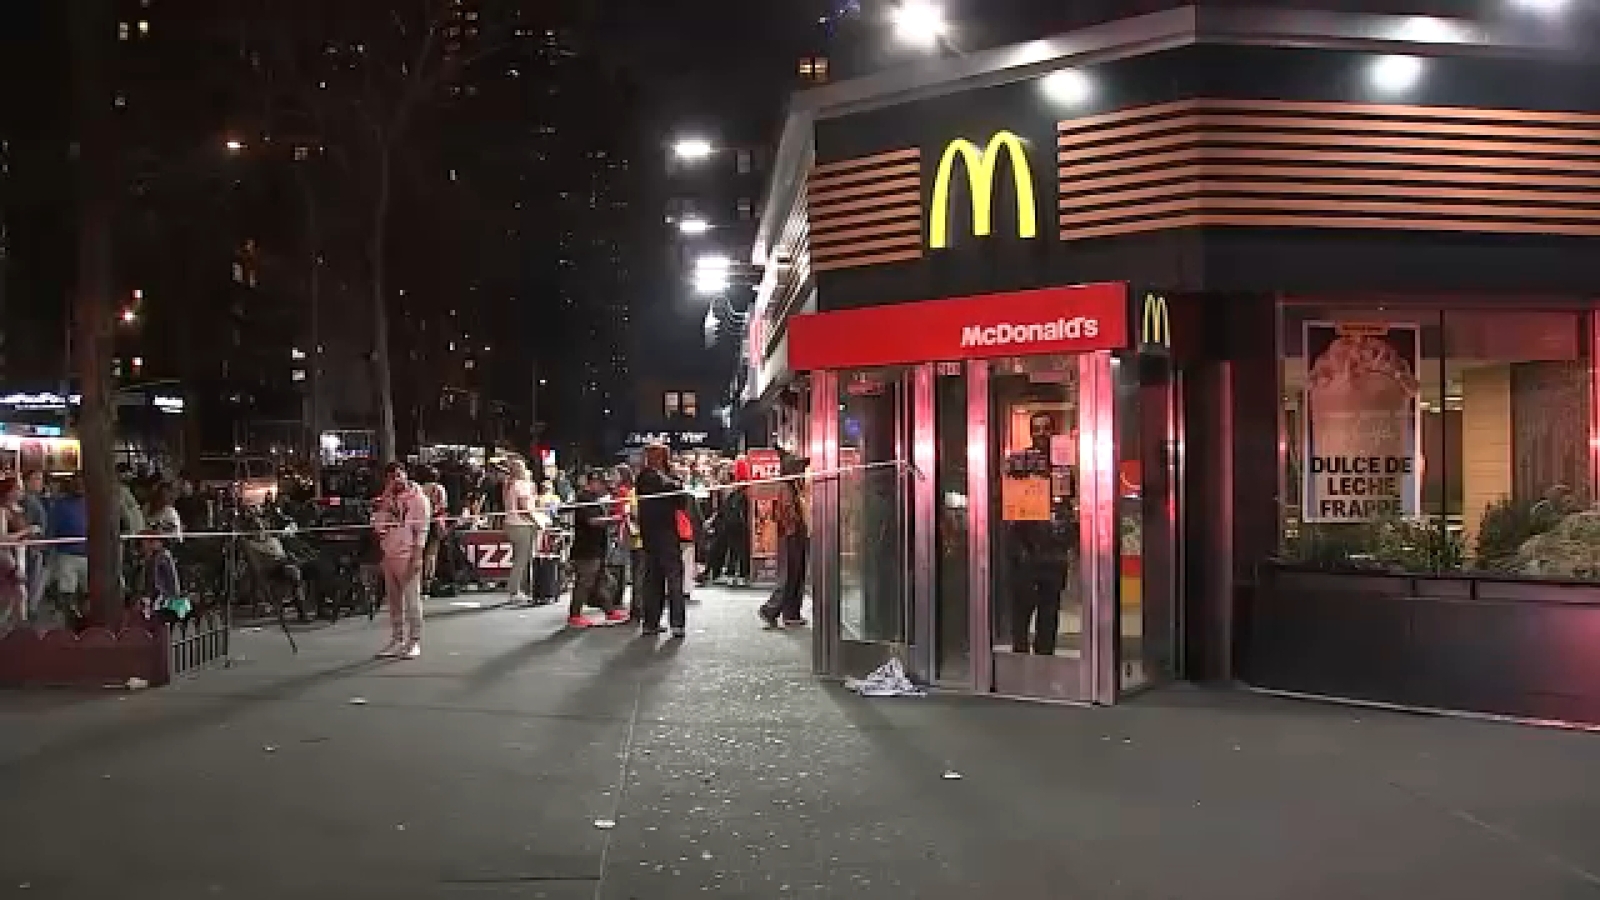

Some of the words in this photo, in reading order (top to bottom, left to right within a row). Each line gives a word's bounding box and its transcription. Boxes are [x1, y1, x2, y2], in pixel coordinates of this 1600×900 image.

[960, 316, 1099, 348] McDonald's
[1310, 457, 1380, 474] DULCE
[1384, 457, 1412, 474] DE
[1327, 477, 1396, 495] LECHE
[460, 541, 513, 568] IZZ
